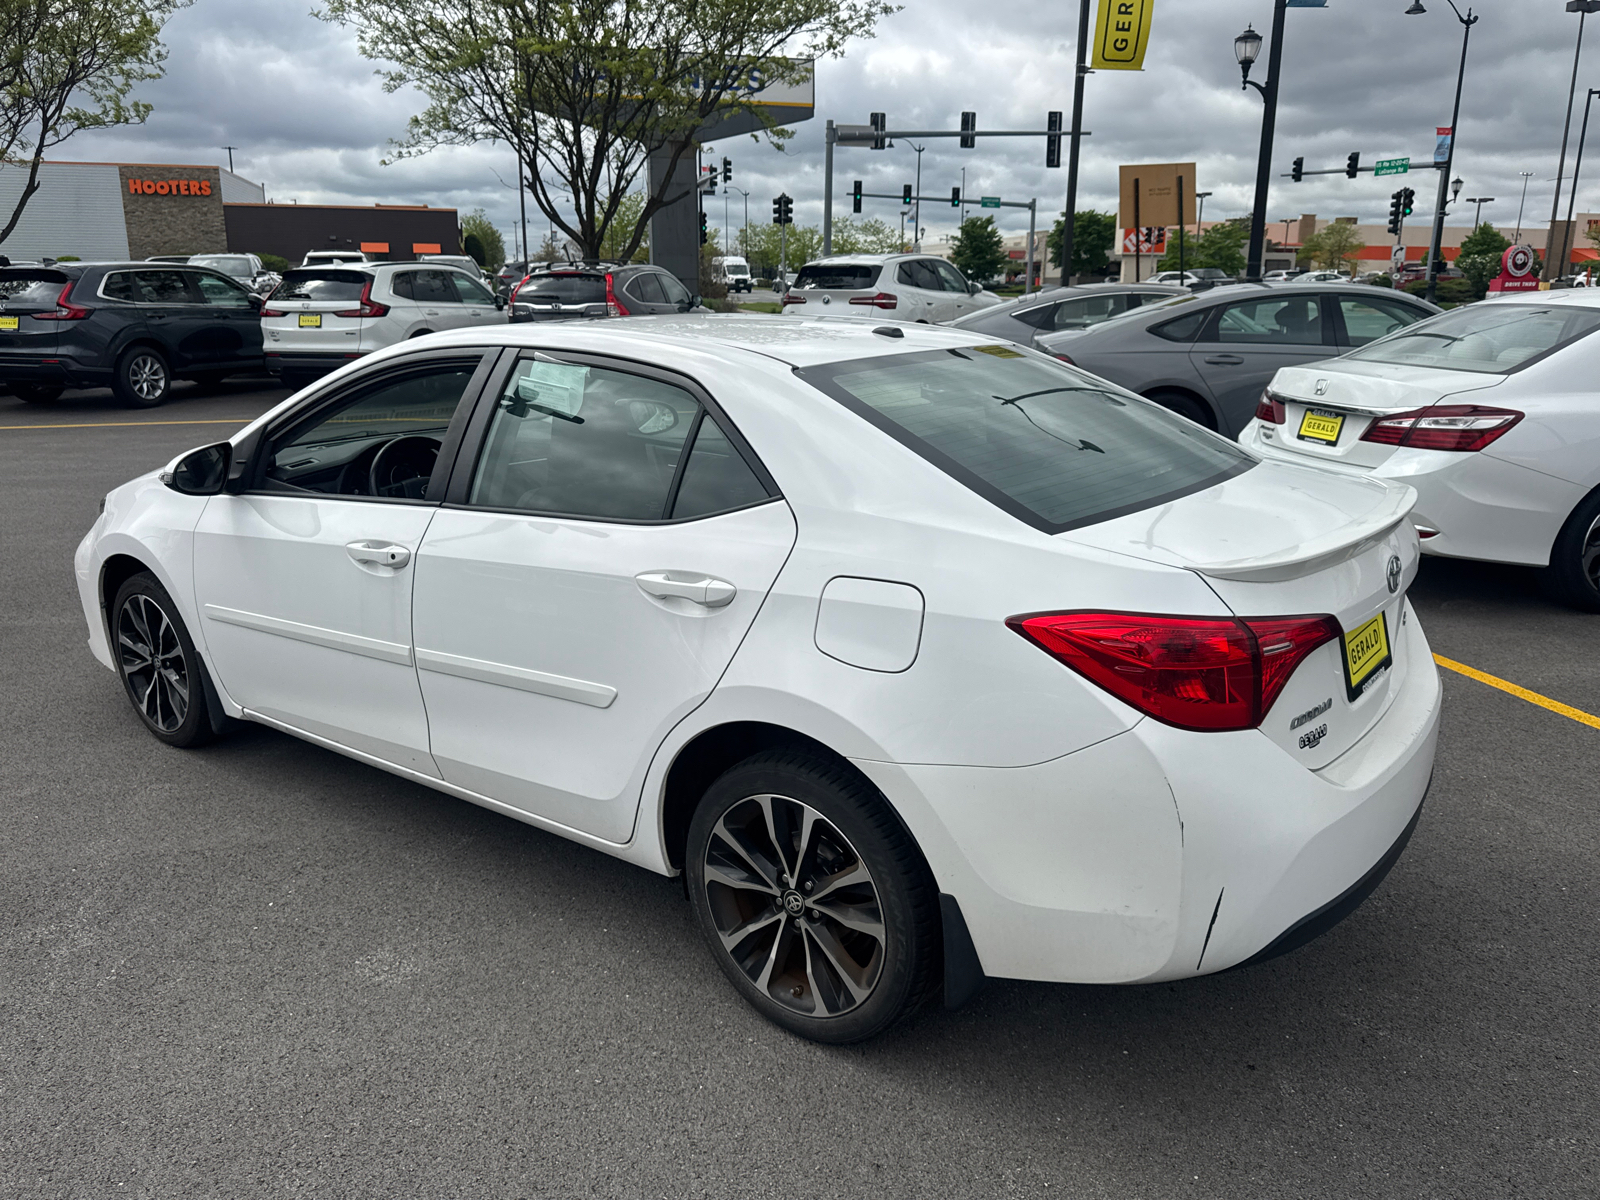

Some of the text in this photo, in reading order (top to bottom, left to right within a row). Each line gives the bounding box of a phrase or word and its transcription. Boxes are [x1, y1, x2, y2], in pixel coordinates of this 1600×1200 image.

[128, 179, 212, 196] HOOTERS
[1313, 409, 1337, 418] GERALD
[1307, 421, 1335, 433] GERALD
[1351, 629, 1379, 665] GERALD
[1299, 723, 1328, 749] GERALD
